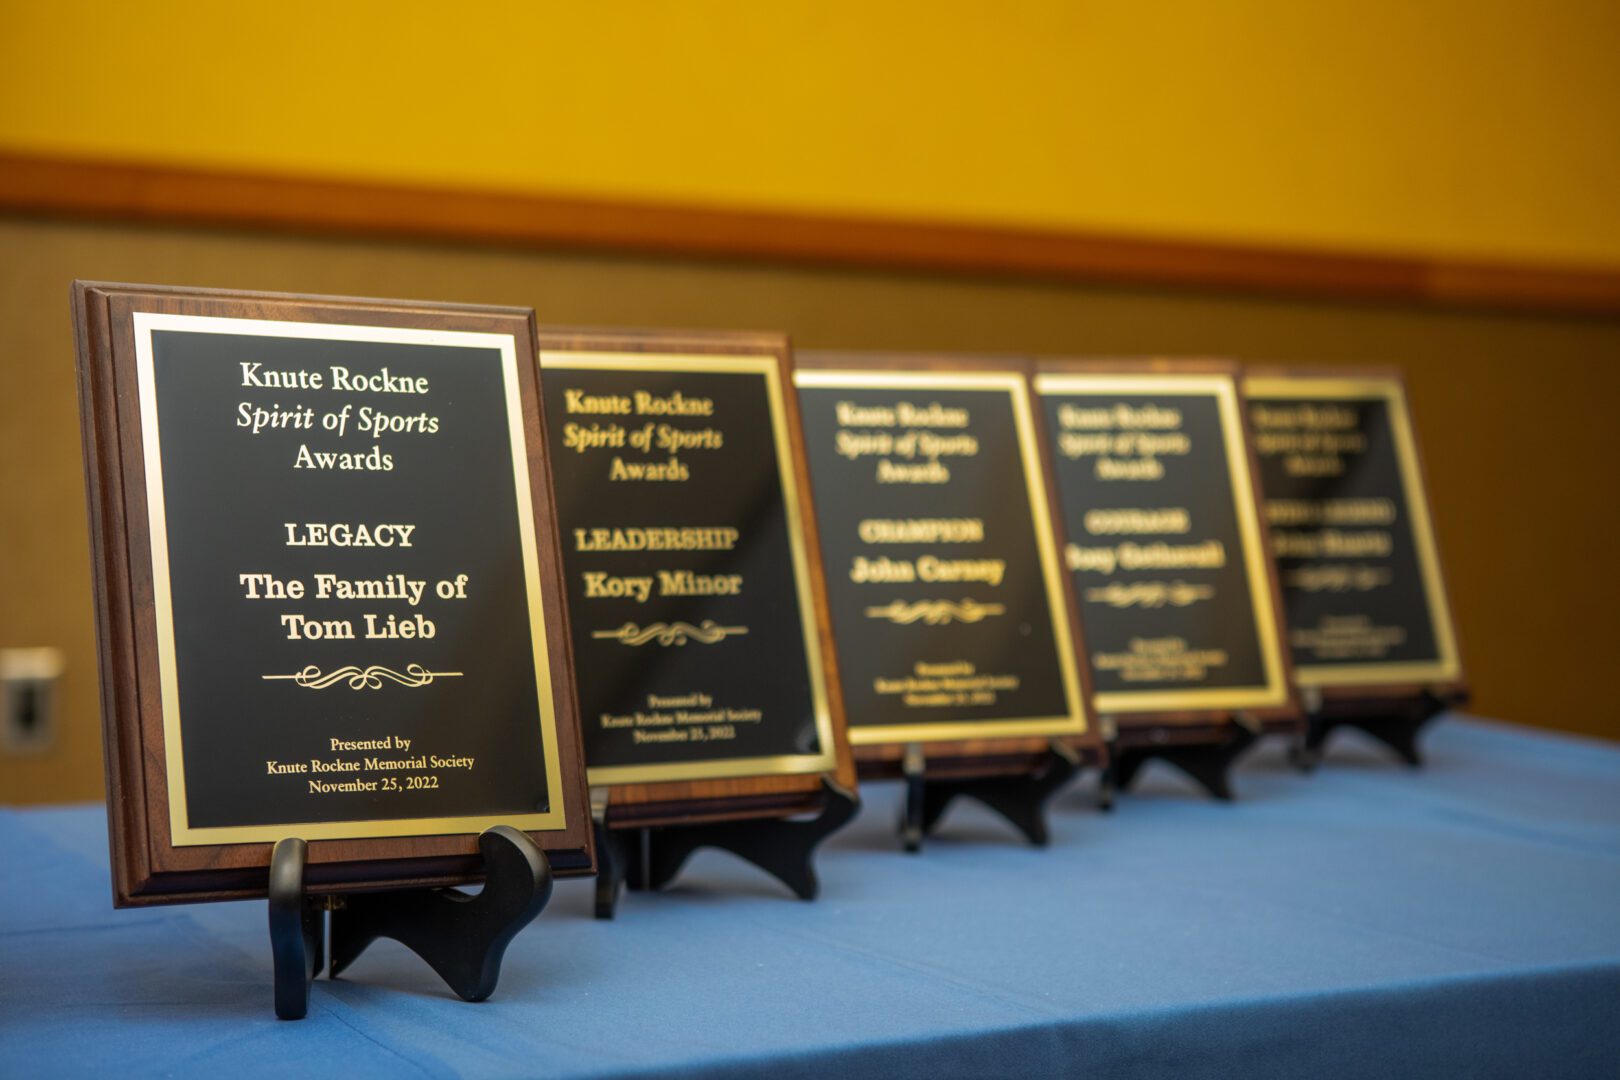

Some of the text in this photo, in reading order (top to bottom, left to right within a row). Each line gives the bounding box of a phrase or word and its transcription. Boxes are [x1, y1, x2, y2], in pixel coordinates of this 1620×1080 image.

[240, 362, 429, 394] Knute Rockne
[564, 389, 714, 416] Knute Rockne
[237, 402, 440, 438] Spirit of Sports
[563, 422, 723, 454] Spirit of Sports
[294, 444, 394, 471] Awards
[609, 456, 690, 481] Awards
[284, 523, 415, 547] LEGACY
[574, 527, 739, 551] LEADERSHIP
[239, 574, 469, 606] The Family of
[583, 570, 743, 603] Kory Minor
[281, 614, 436, 640] Tom Lieb
[330, 736, 411, 752] Presented by
[266, 755, 475, 775] Knute Rockne Memorial Society
[308, 776, 439, 793] November 25, 2022
